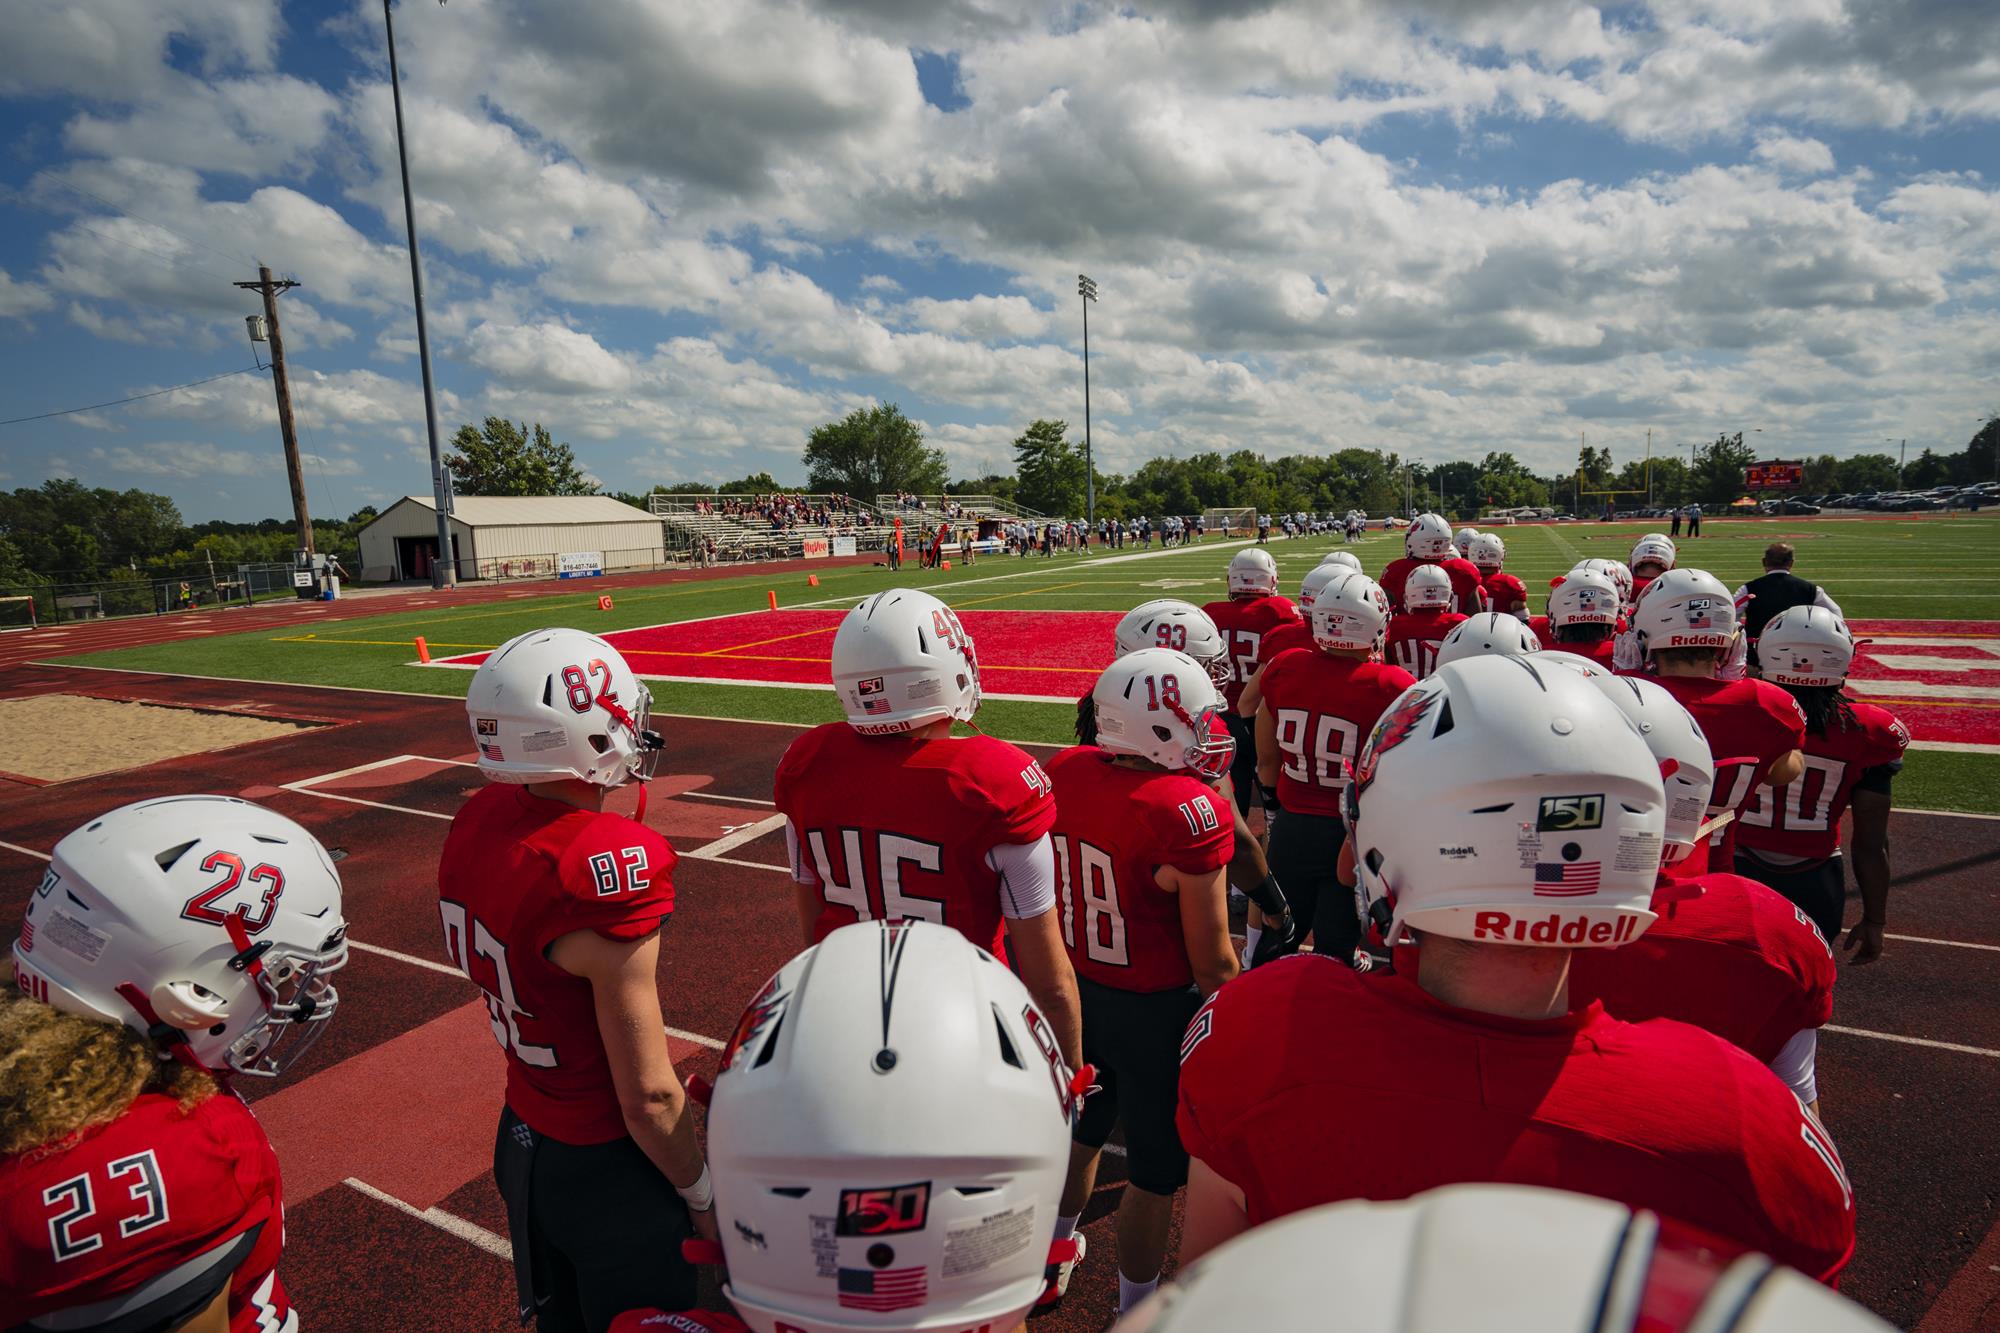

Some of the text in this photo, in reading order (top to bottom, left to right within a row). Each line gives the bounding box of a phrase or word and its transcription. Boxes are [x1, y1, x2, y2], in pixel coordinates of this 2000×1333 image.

[602, 597, 612, 609] G
[1568, 614, 1606, 623] Riddell
[1155, 623, 1187, 651] 93
[1318, 637, 1354, 649] Riddell
[1671, 635, 1725, 646] Riddell
[561, 658, 619, 713] 82
[1145, 674, 1181, 712] 18
[1776, 674, 1829, 686] Riddell
[856, 720, 912, 735] Riddell
[1276, 708, 1359, 789] 98
[1179, 795, 1219, 836] 18
[1542, 796, 1602, 829] 150
[588, 845, 650, 897] 82
[179, 850, 286, 936] 23
[1053, 833, 1130, 968] 18
[1473, 911, 1638, 944] Riddell
[42, 1148, 170, 1263] 23
[842, 1186, 928, 1234] 150
